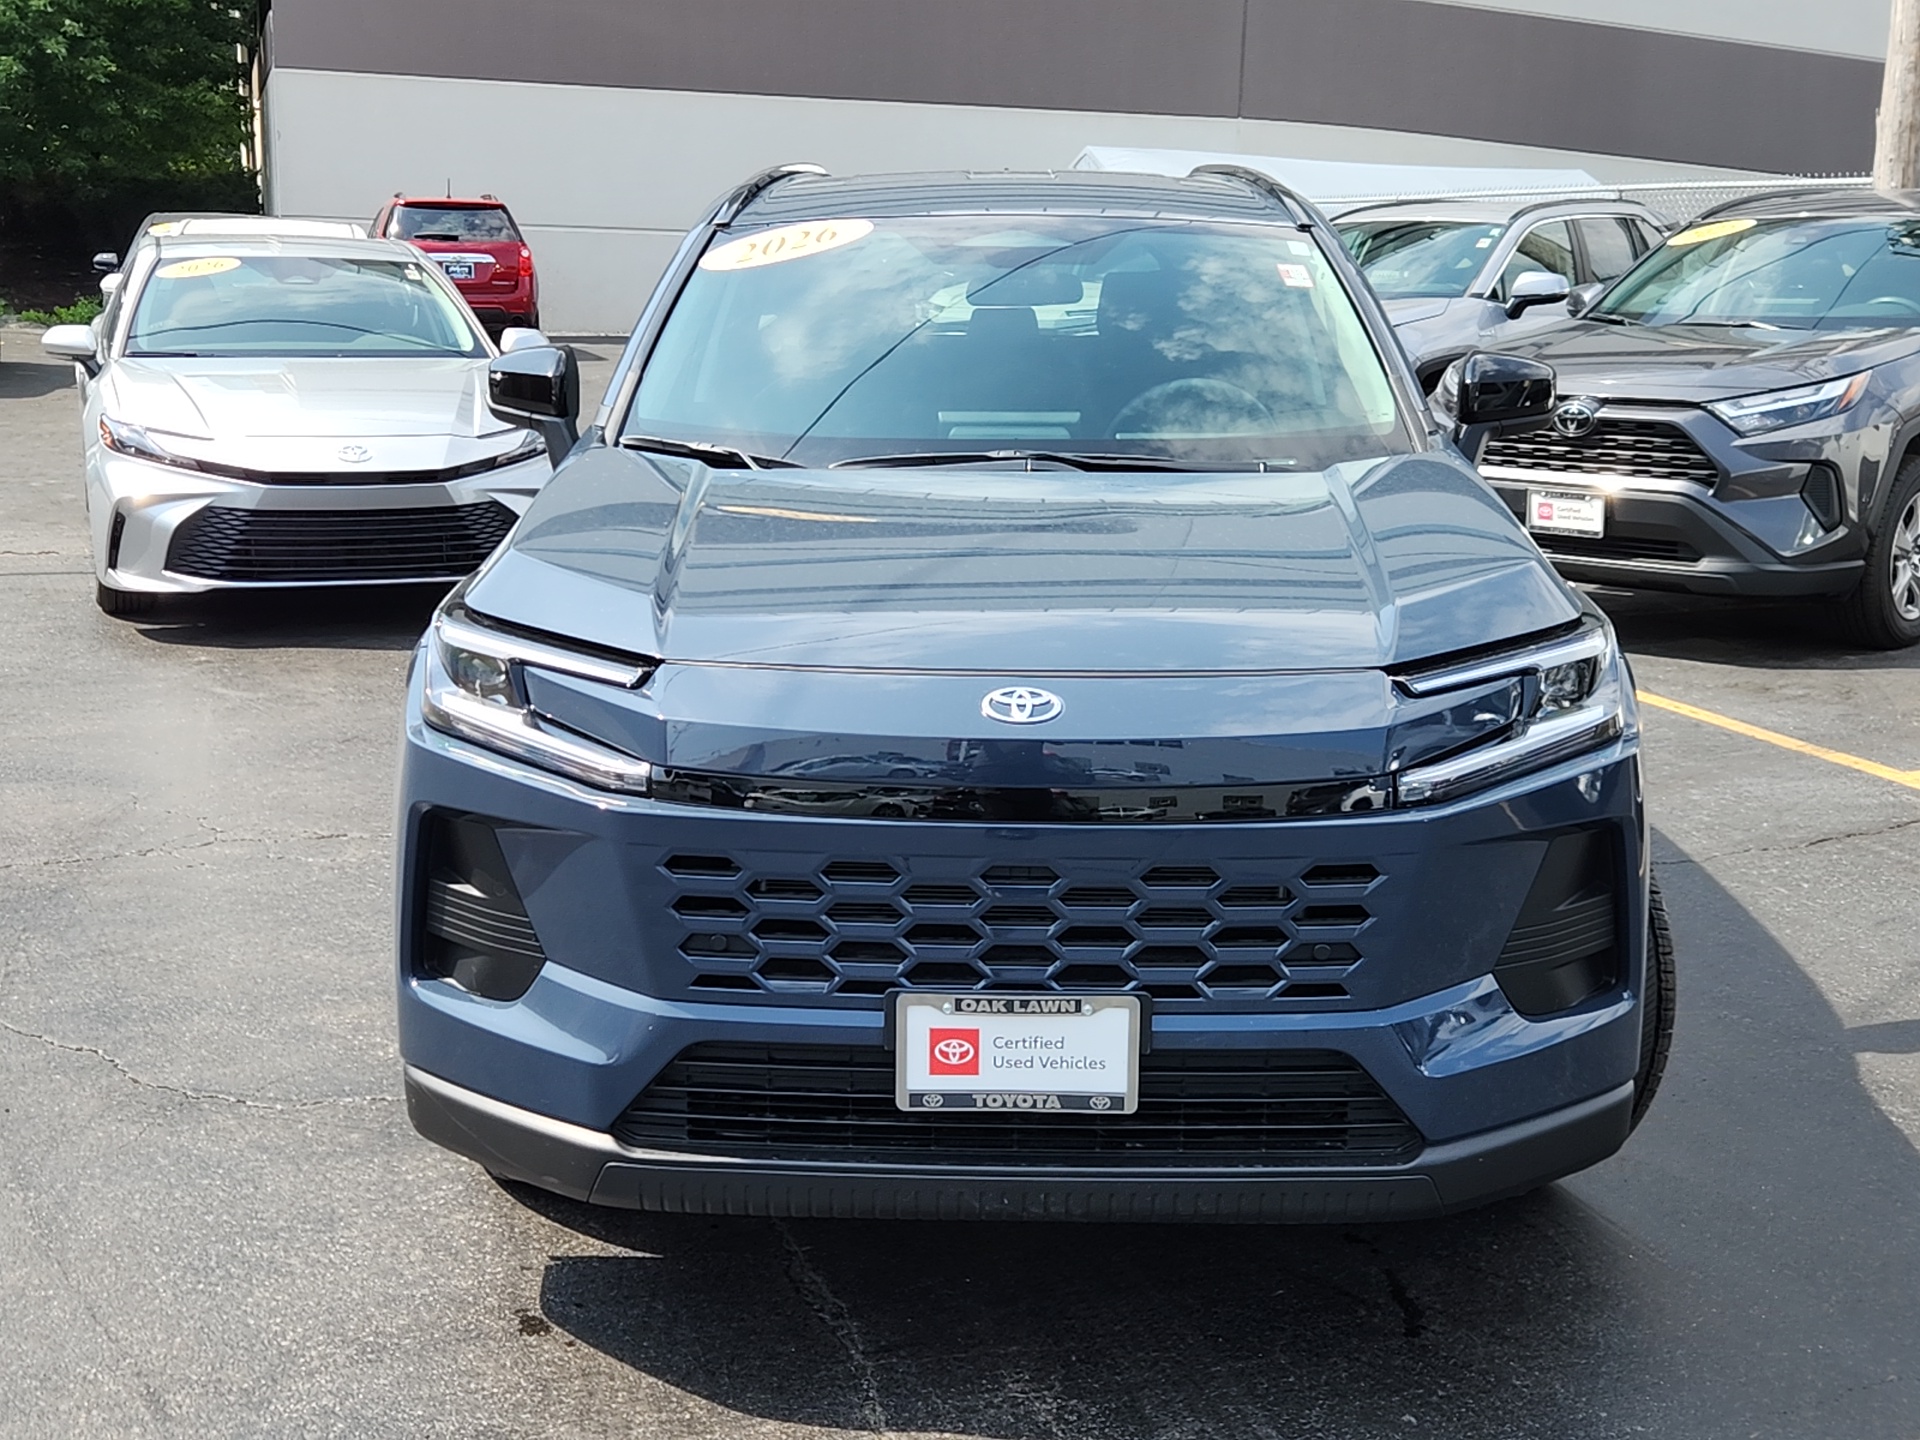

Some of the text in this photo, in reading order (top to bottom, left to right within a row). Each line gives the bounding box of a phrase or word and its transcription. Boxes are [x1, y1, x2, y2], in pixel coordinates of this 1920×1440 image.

[960, 999, 1077, 1014] OAK LAWN
[993, 1036, 1065, 1050] Certified
[993, 1056, 1106, 1070] Used Vehicles
[972, 1094, 1062, 1109] TOYOTA
